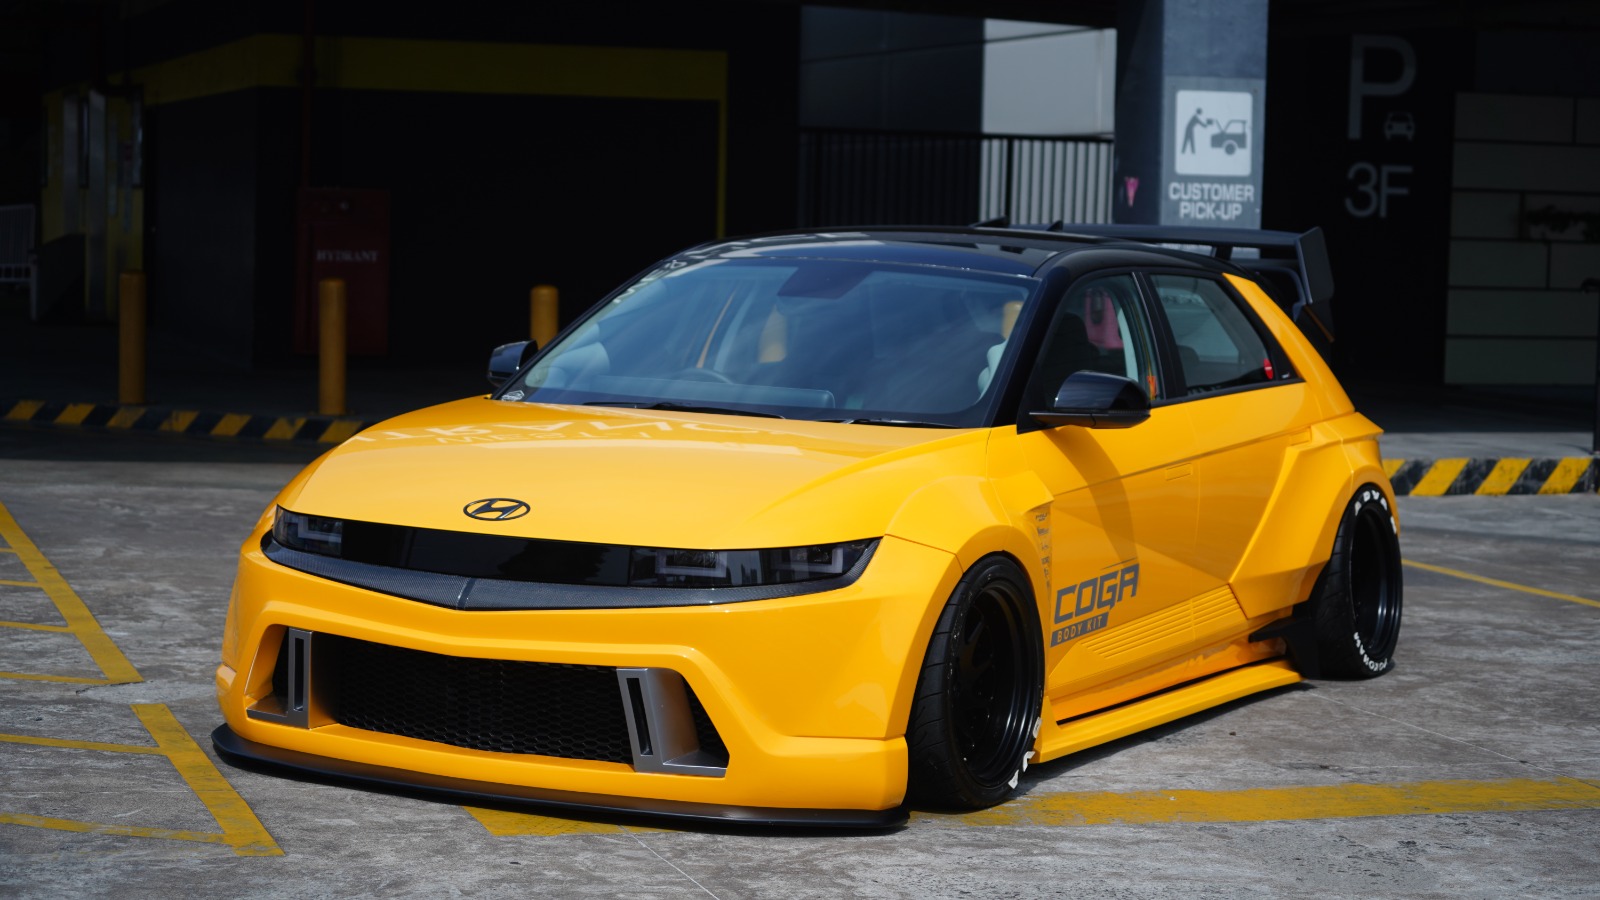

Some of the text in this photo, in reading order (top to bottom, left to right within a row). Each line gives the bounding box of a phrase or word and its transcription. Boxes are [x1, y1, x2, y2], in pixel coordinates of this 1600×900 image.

[1347, 33, 1417, 141] P
[1168, 182, 1255, 203] CUSTOMER
[1344, 160, 1415, 219] 3F
[1179, 201, 1243, 221] PICK-UP
[315, 249, 379, 263] HYDRANT
[1053, 562, 1140, 625] COGA
[1057, 615, 1103, 643] BODY KIT
